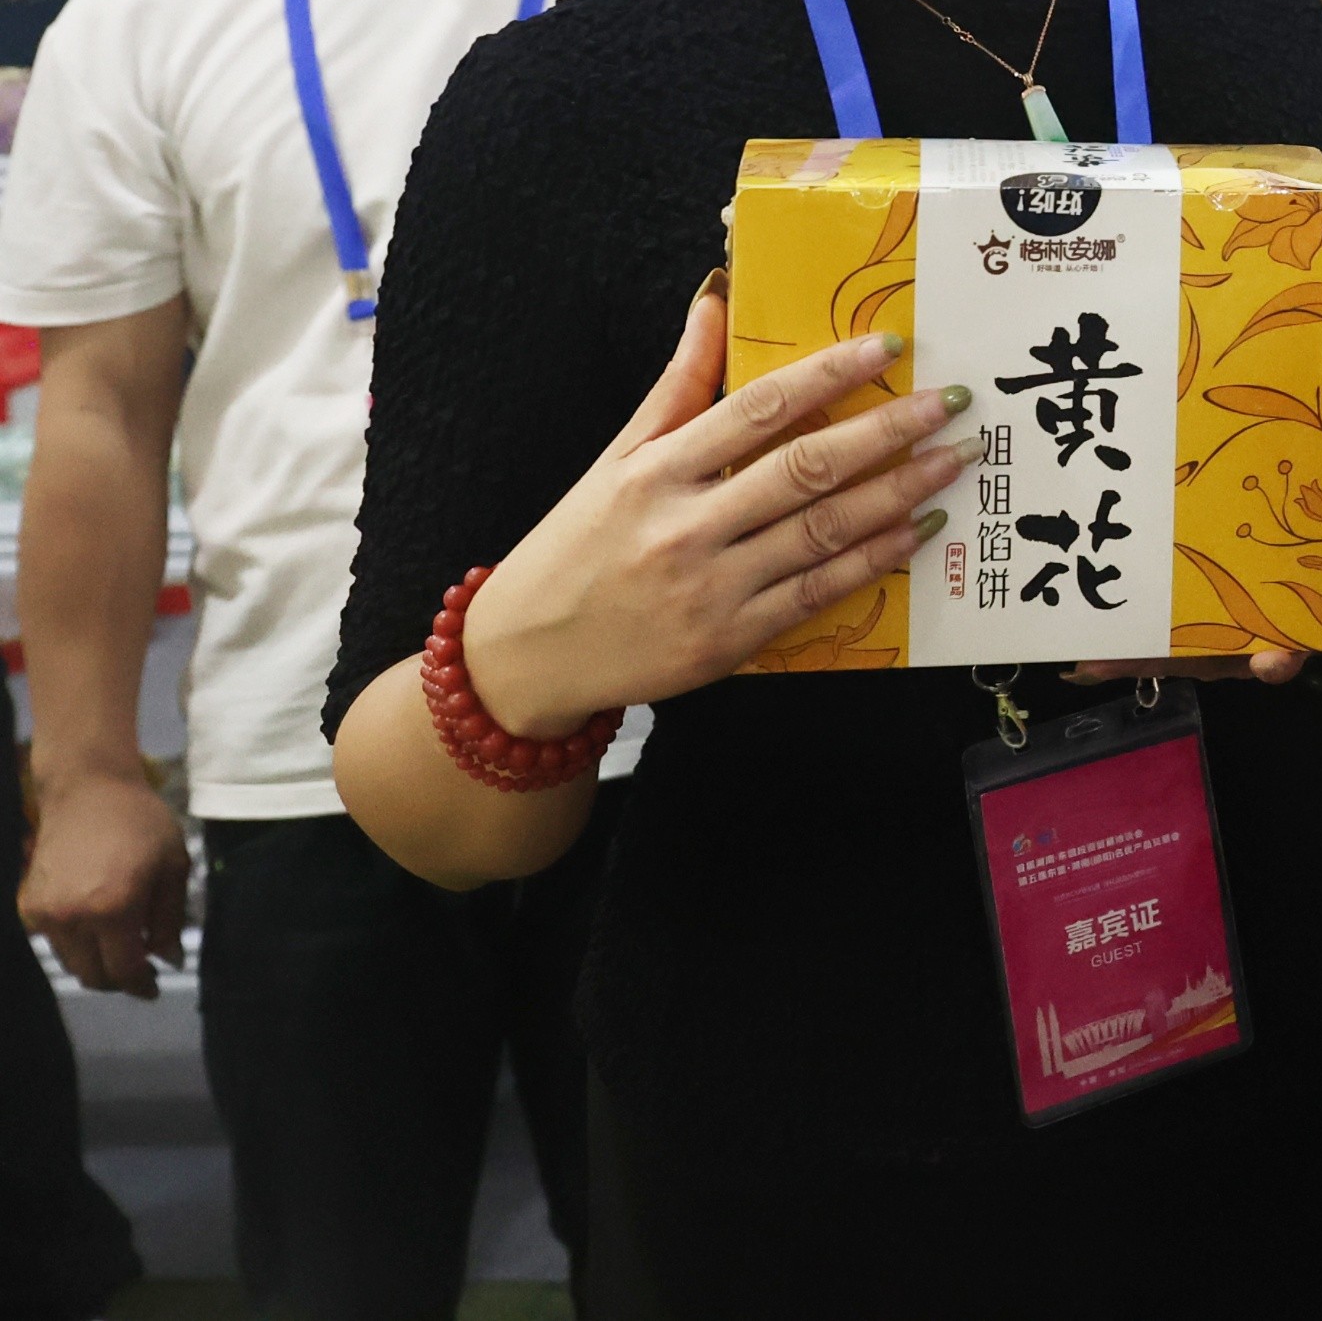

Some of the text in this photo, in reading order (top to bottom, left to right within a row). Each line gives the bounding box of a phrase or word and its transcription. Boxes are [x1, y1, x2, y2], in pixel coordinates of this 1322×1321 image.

[1019, 236, 1117, 262] 格林安娜
[994, 312, 1143, 611] 黄花
[976, 423, 1013, 610] 姐姐馅饼
[1064, 897, 1163, 956] 嘉宾证
[1090, 941, 1143, 969] GUEST
